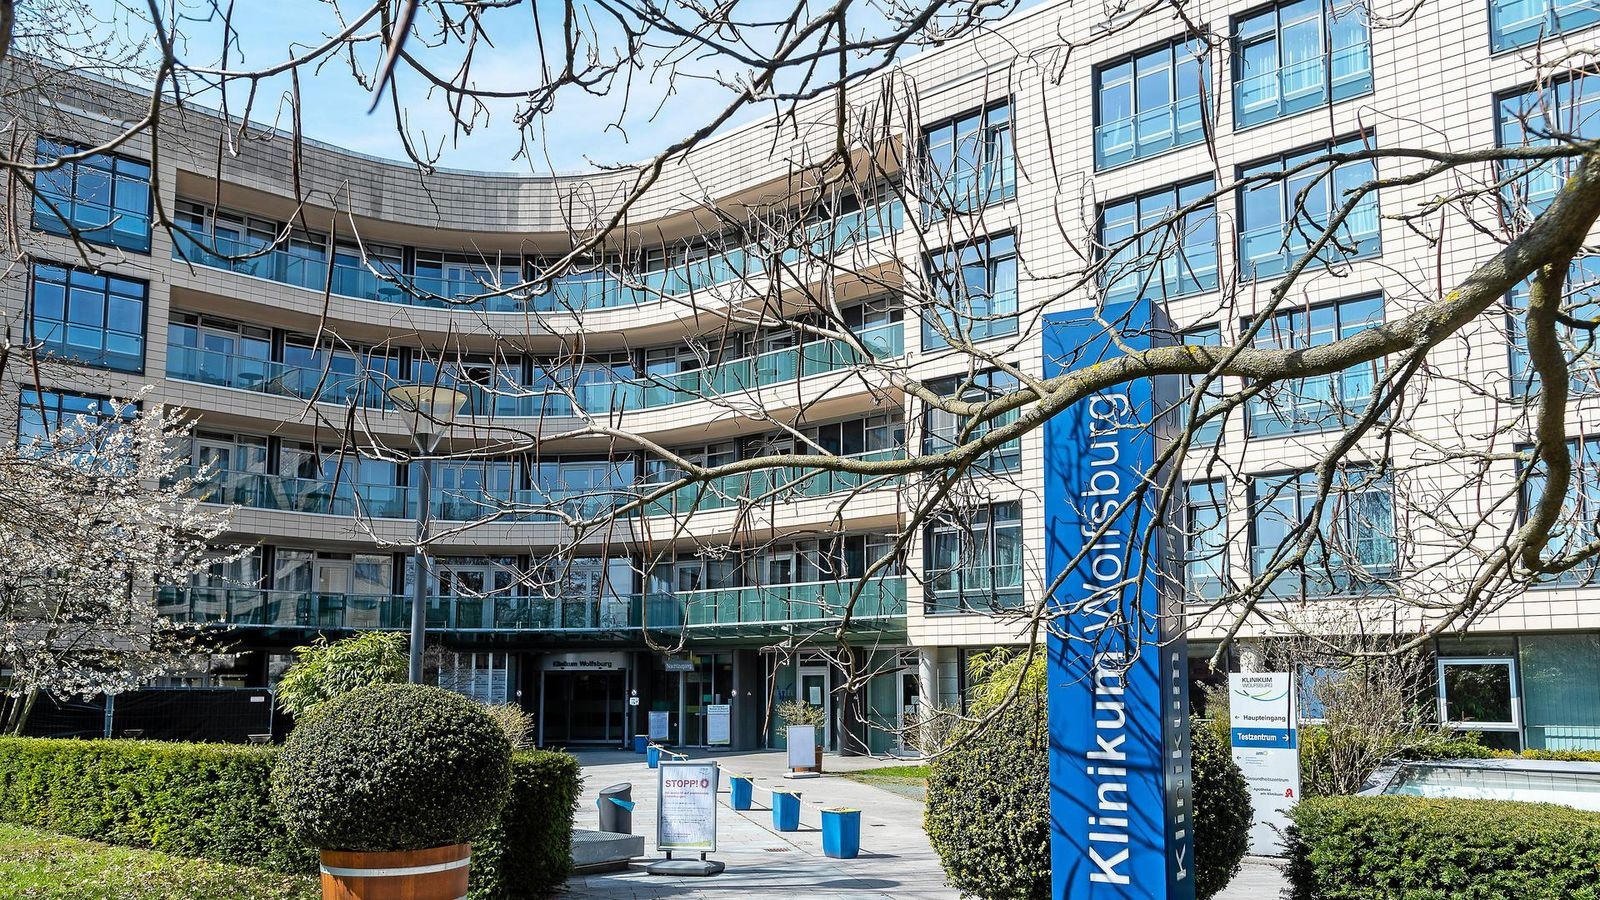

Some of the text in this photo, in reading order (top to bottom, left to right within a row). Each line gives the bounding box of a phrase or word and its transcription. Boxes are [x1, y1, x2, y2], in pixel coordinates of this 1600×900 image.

[1081, 393, 1130, 885] Klinikum Wolfsburg
[579, 660, 612, 668] Wolfsburg
[1243, 714, 1286, 722] Haupteingang
[1237, 732, 1277, 741] Testzentrum
[1171, 652, 1187, 881] Klinikum
[665, 779, 699, 788] STOPP!
